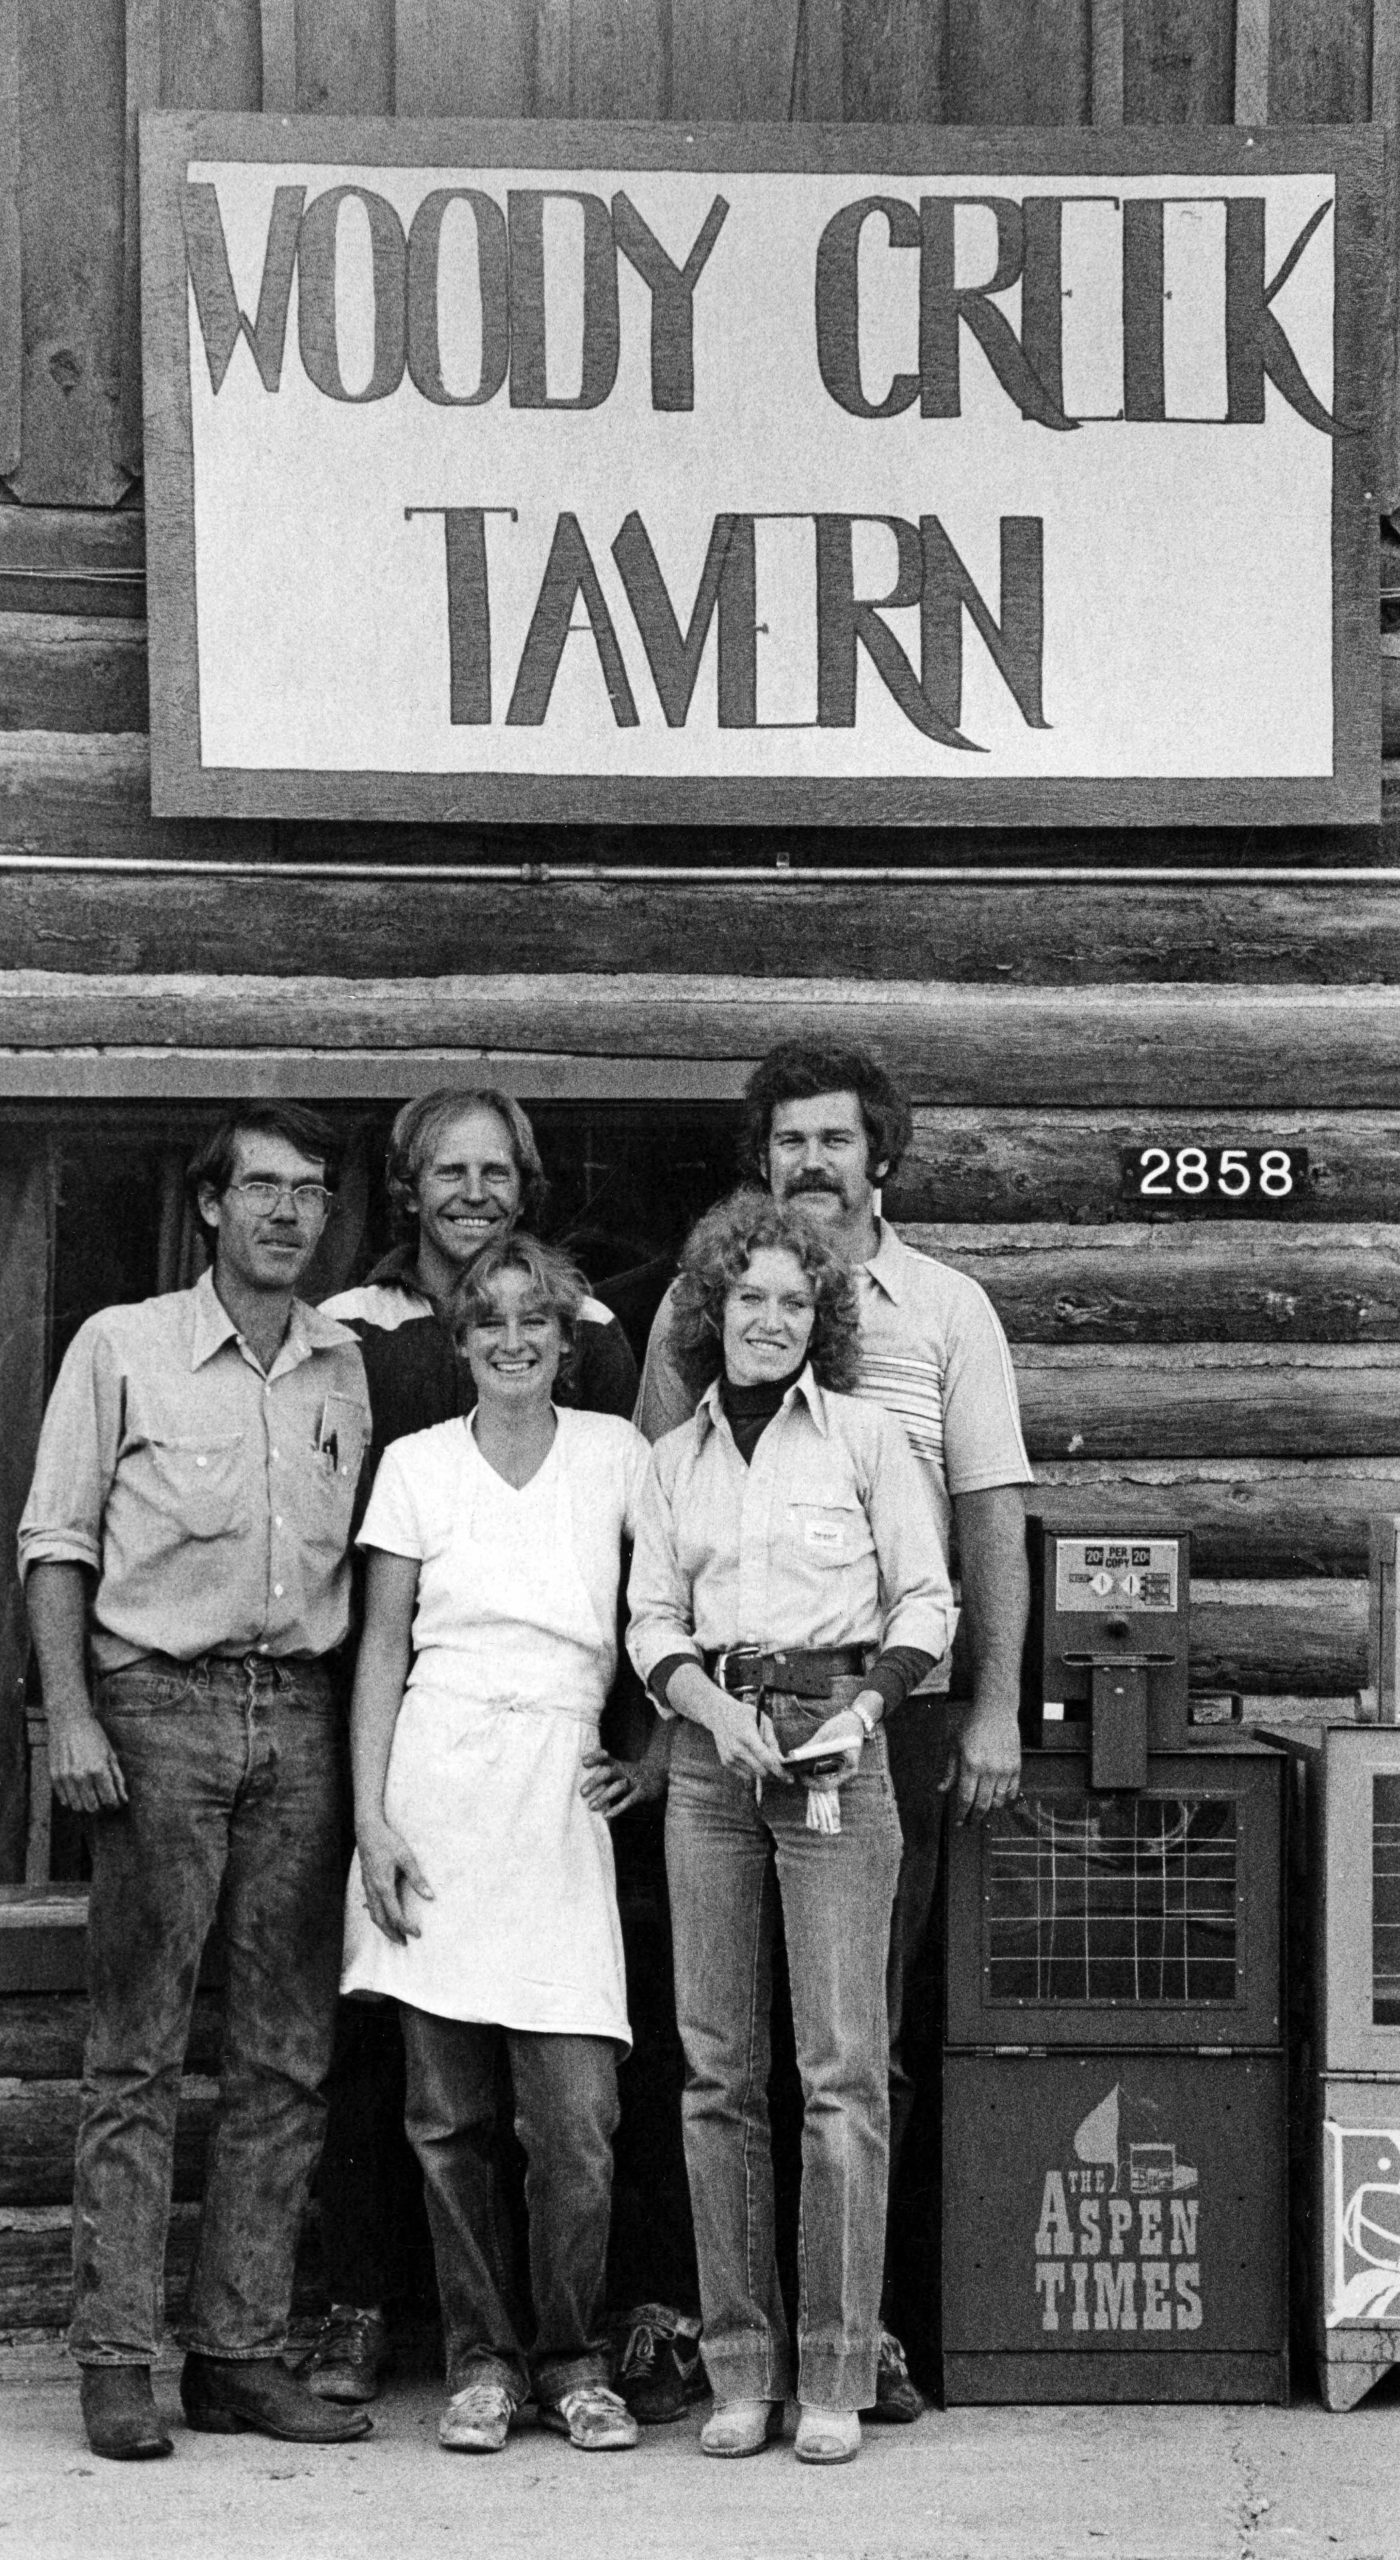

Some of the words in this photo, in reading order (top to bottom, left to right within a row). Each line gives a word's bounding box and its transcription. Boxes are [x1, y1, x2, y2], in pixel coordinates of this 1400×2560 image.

[181, 180, 730, 411] WOODY
[815, 194, 1368, 438] CREEK
[404, 505, 1054, 752] TAVERN
[1140, 1147, 1293, 1196] 2858
[1105, 1558, 1130, 1568] COPY
[1108, 1547, 1128, 1557] PER
[1067, 2170, 1105, 2193] THE
[1034, 2170, 1200, 2255] ASPEN
[1035, 2262, 1203, 2330] TIMES
